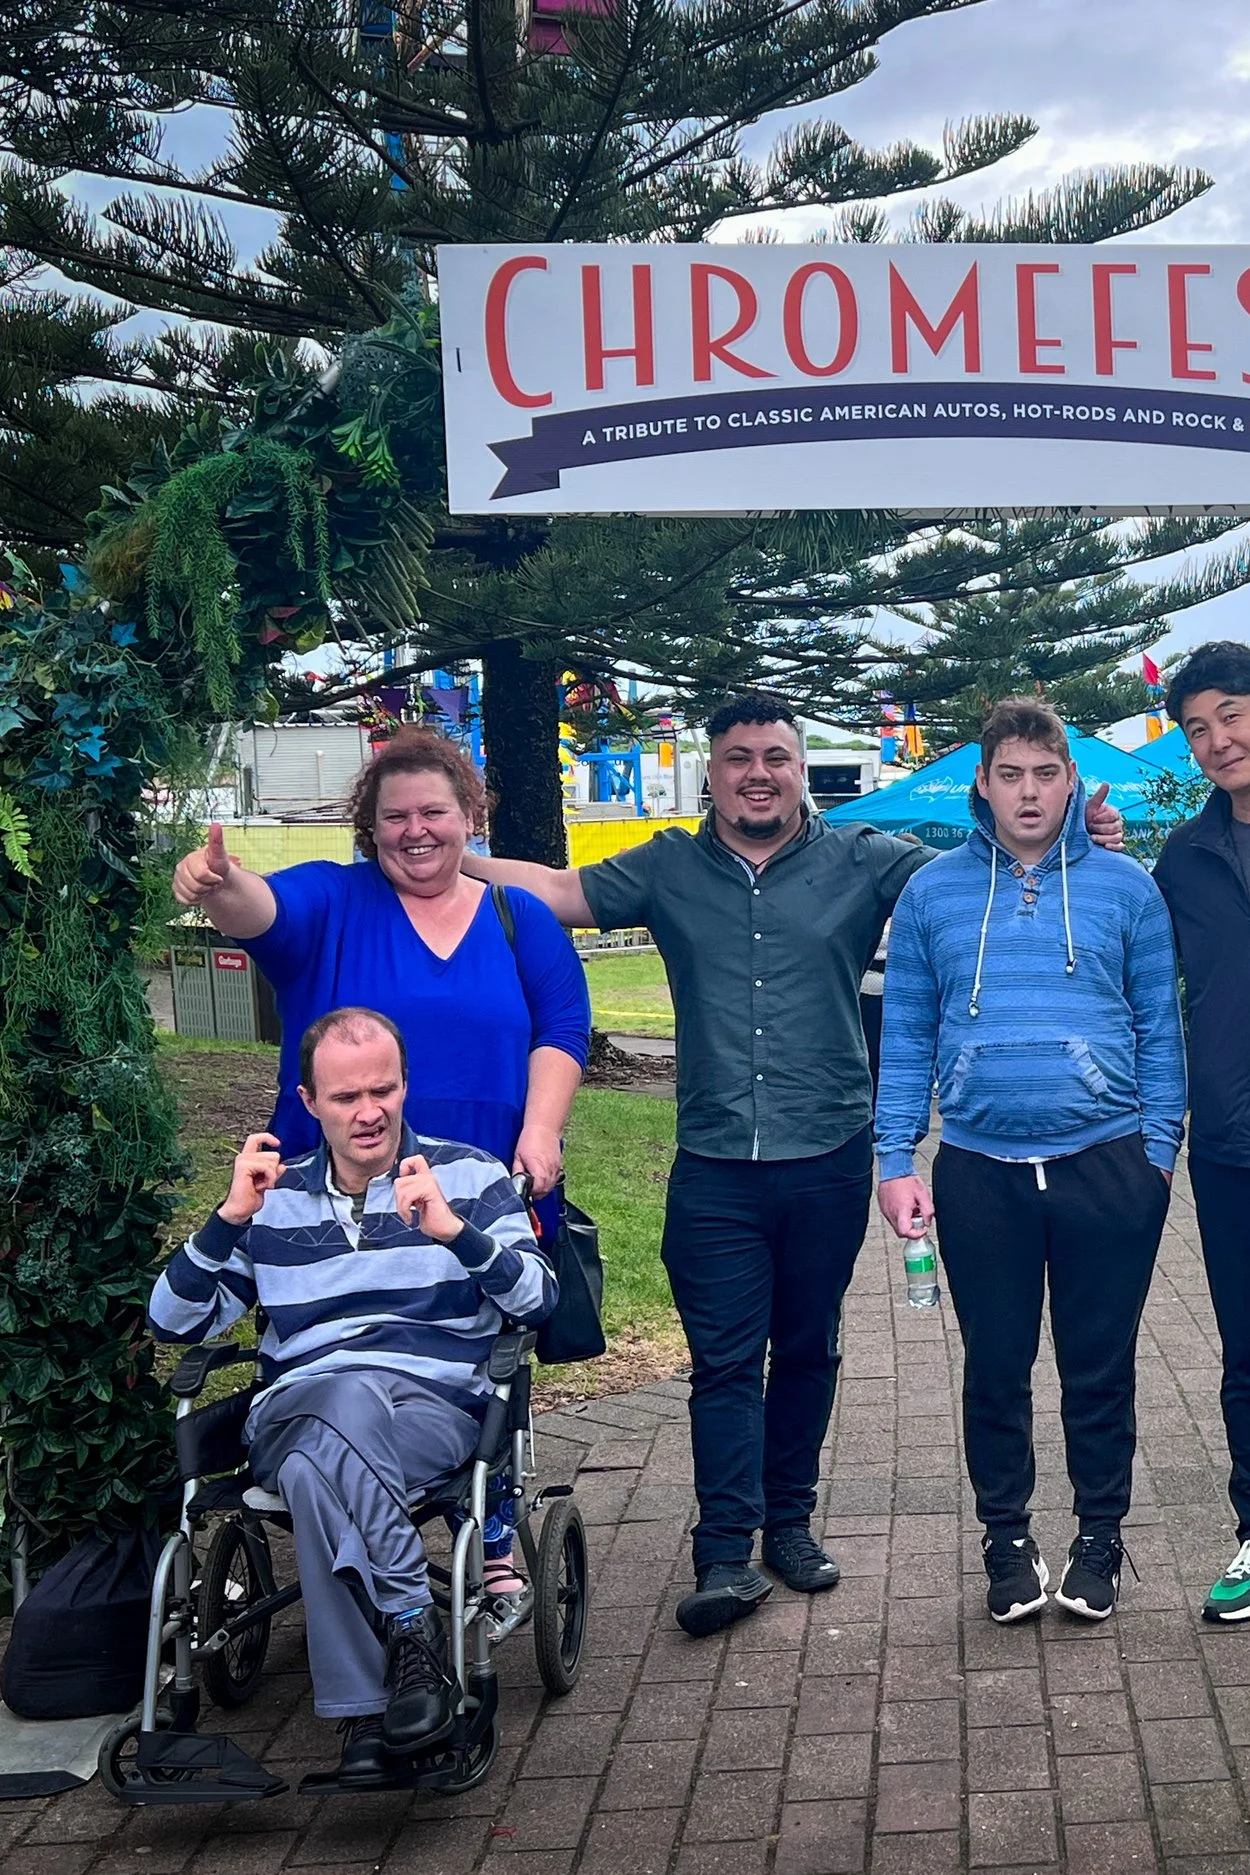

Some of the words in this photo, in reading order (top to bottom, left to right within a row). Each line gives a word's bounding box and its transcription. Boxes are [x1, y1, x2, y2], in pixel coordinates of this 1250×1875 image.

[582, 430, 596, 446] A
[602, 418, 688, 442] TRIBUTE
[693, 415, 721, 431] TO
[727, 407, 813, 428] CLASSIC
[819, 403, 927, 421] AMERICAN
[933, 403, 1007, 421] AUTOS,
[1013, 403, 1116, 422] HOT-RODS
[1122, 408, 1165, 425] AND
[1172, 411, 1227, 430] ROCK
[1232, 417, 1245, 432] &
[925, 827, 949, 839] 1300
